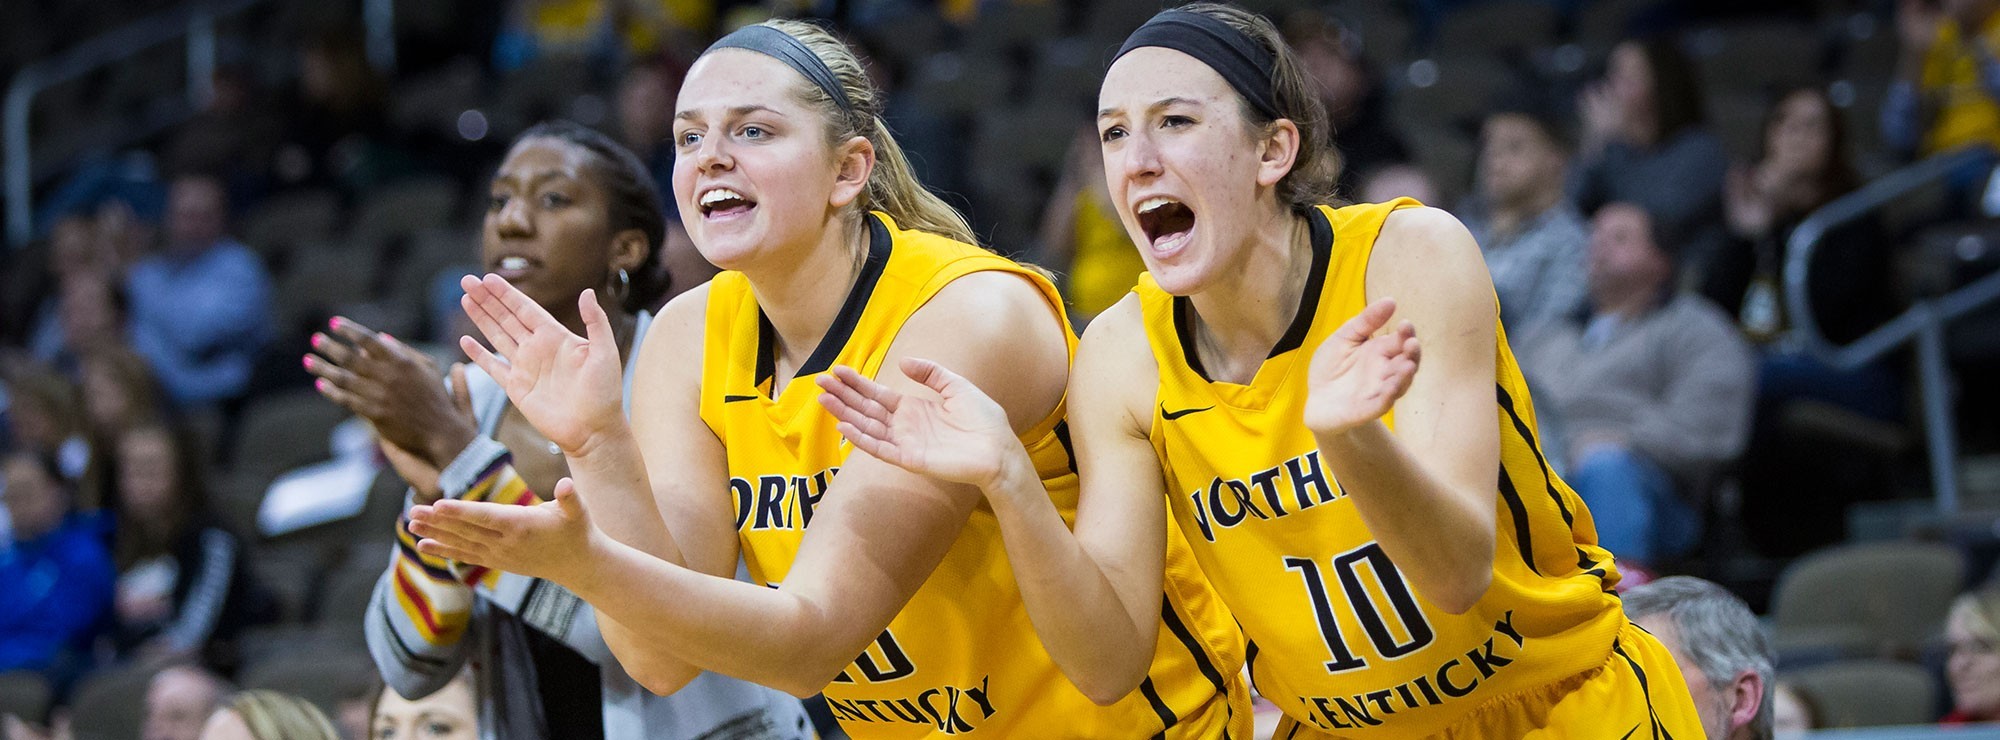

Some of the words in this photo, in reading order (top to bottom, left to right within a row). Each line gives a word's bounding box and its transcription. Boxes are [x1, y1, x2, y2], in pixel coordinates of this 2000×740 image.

[729, 466, 841, 532] ORH
[1190, 449, 1348, 542] NORTH
[1282, 540, 1436, 675] 10
[826, 674, 997, 735] NTUCKY
